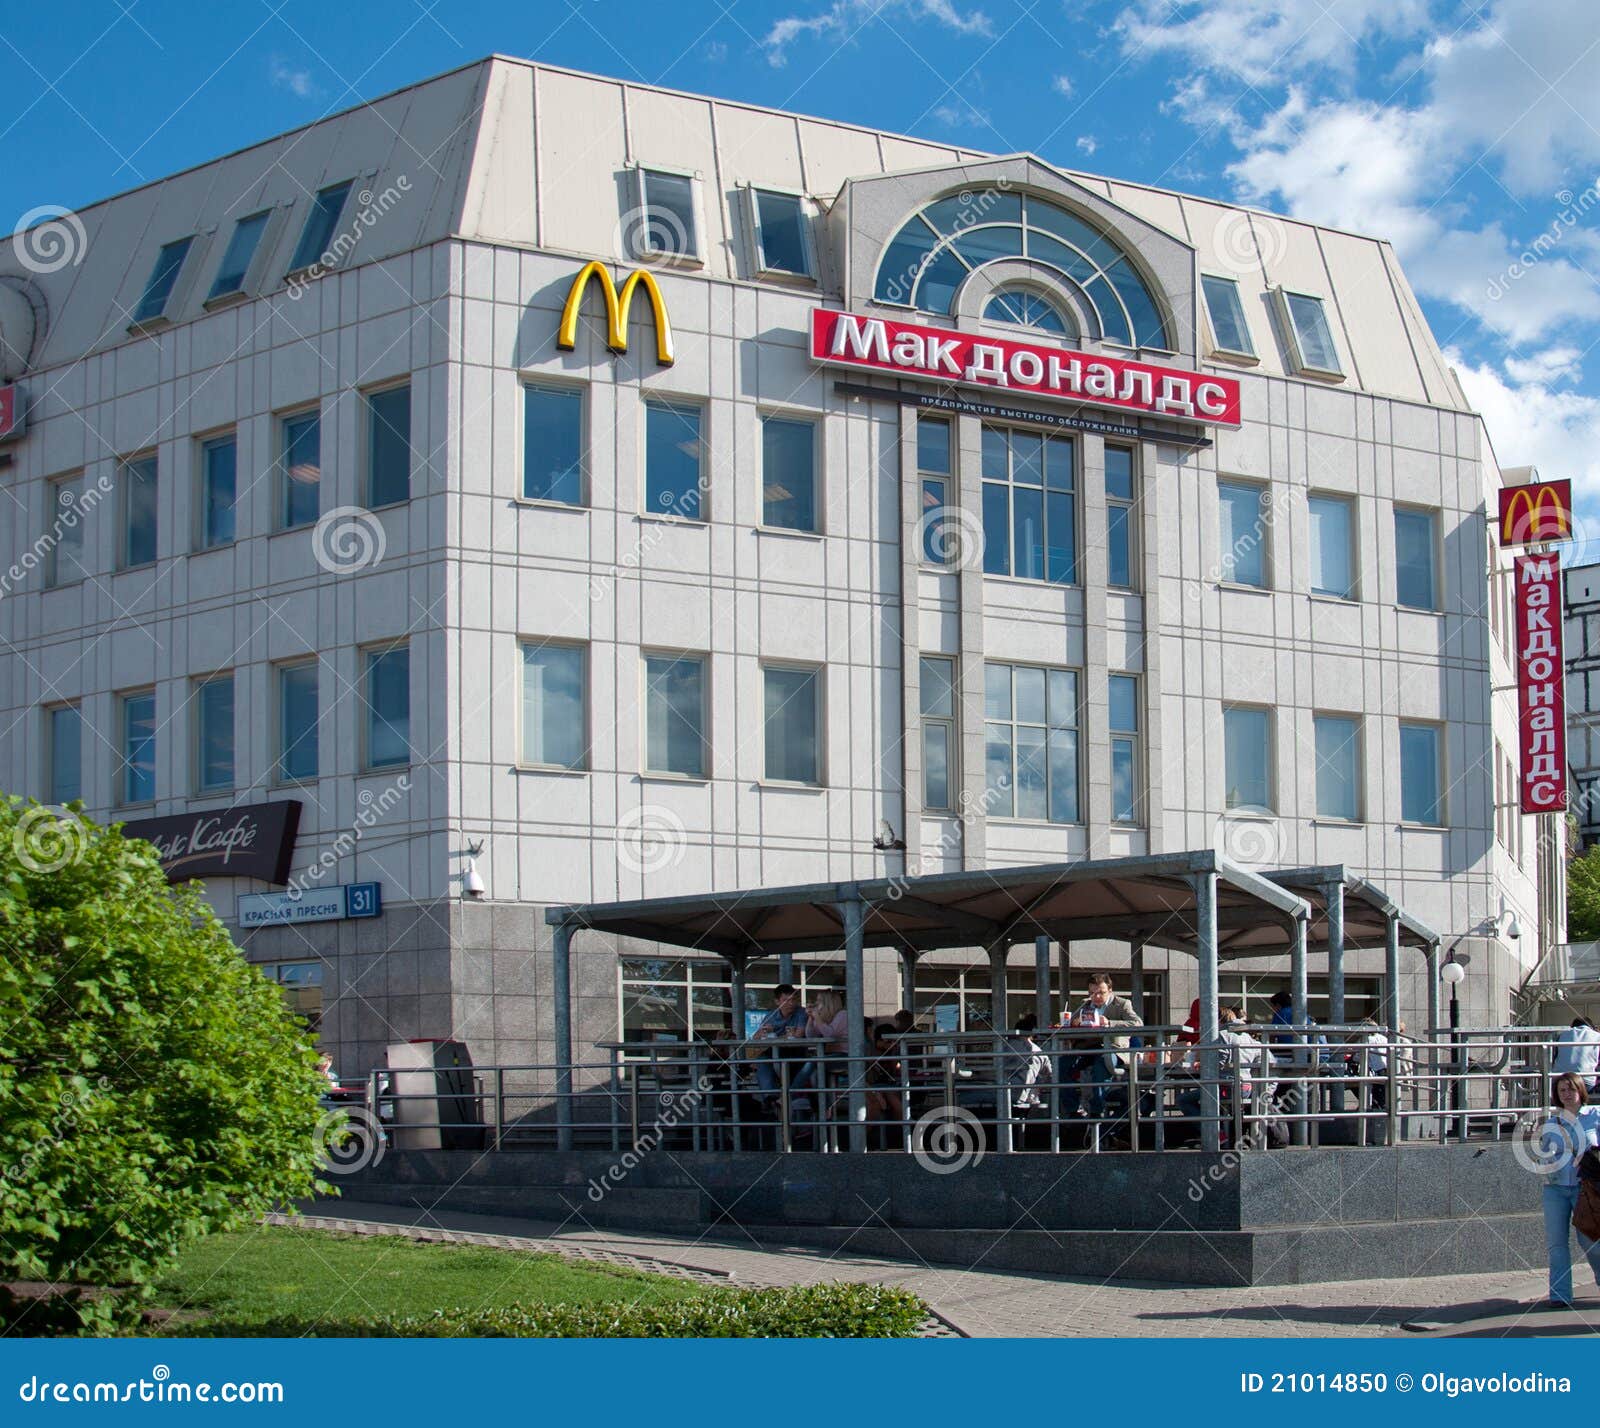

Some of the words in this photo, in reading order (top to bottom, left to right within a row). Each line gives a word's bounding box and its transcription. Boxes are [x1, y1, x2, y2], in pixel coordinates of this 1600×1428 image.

[832, 314, 1227, 416] Макдоналдс
[921, 396, 996, 414] ПРЕДПРИЯТИЕ
[1000, 409, 1054, 423] БЫСТРОГО
[1058, 417, 1139, 435] ОБСЛУЖИВАНИЯ
[245, 908, 292, 922] КРАСНАЯ
[297, 903, 339, 917] ПРЕСНЯ
[353, 890, 371, 911] 31
